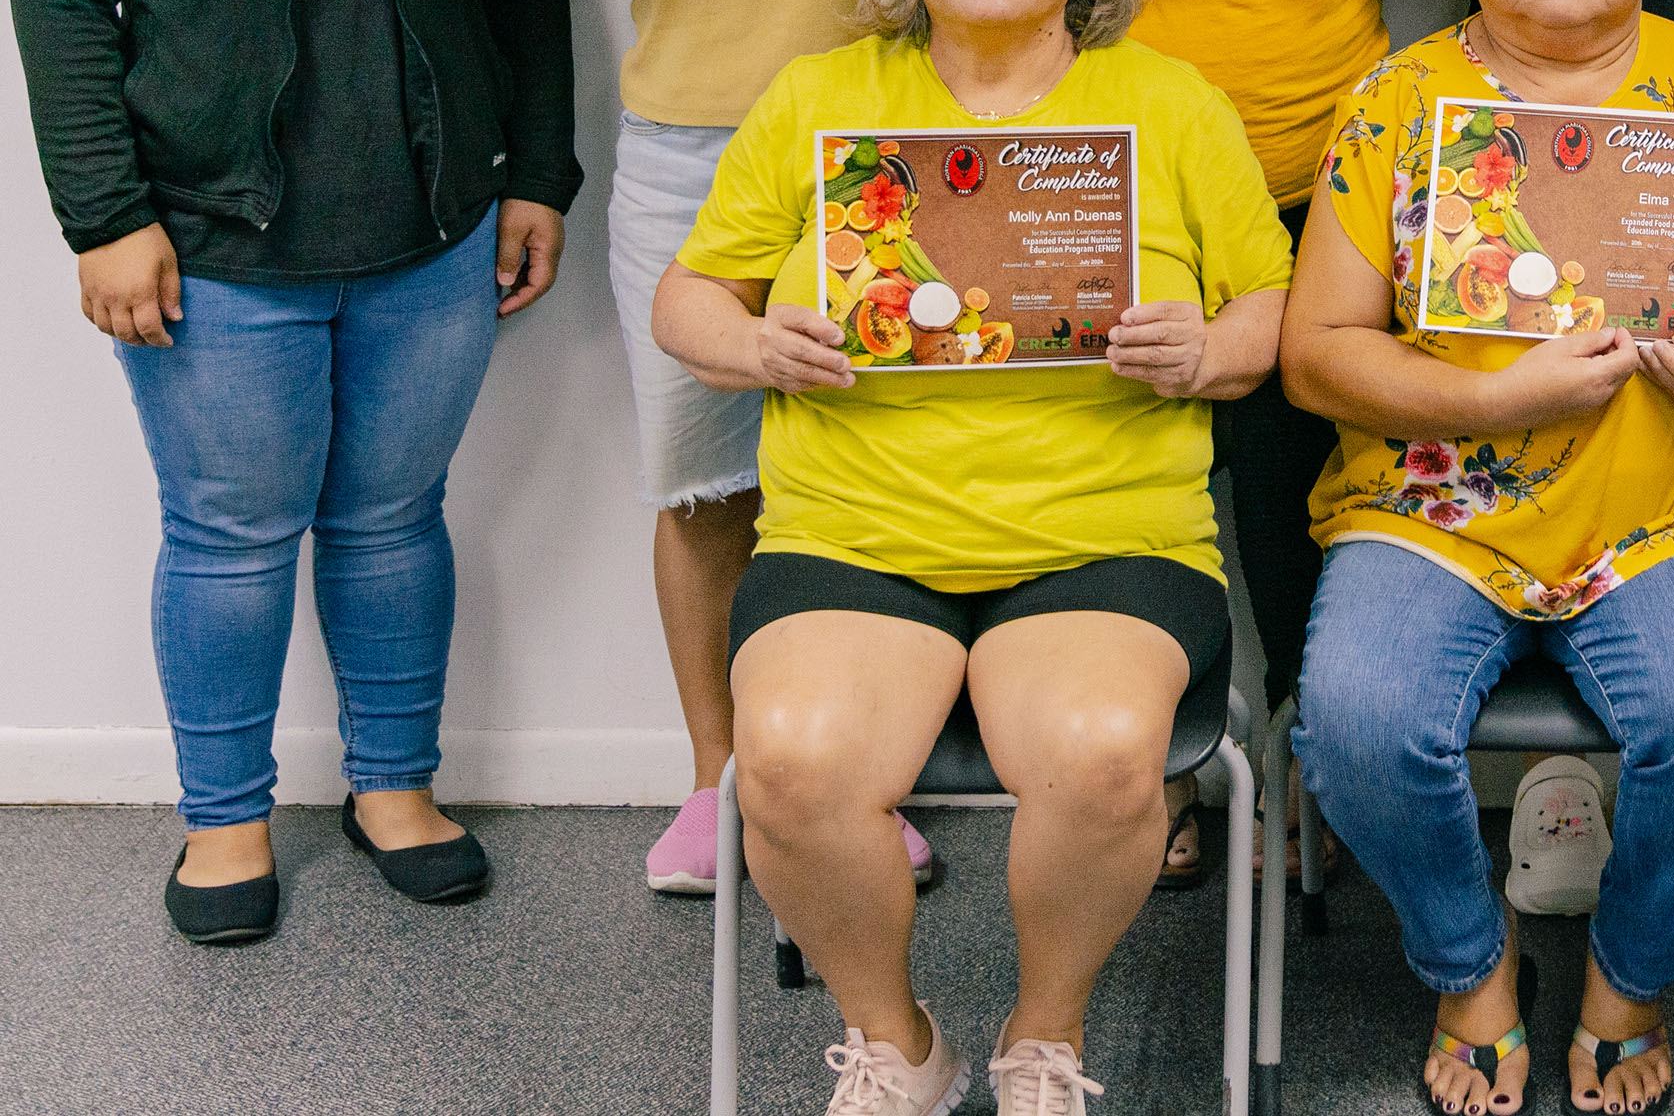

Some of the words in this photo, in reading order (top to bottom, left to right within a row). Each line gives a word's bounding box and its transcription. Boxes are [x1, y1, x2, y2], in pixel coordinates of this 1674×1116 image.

[998, 140, 1096, 170] Certificate
[1099, 142, 1120, 169] of
[1017, 165, 1121, 194] Completion
[1638, 192, 1669, 205] Elma
[1009, 210, 1041, 225] Molly
[1045, 210, 1070, 221] Ann
[1074, 208, 1122, 221] Duenas
[1621, 217, 1653, 227] Expanded
[1654, 219, 1671, 227] Food
[1626, 226, 1659, 235] Education
[1022, 237, 1056, 245] Expanded
[1057, 236, 1074, 244] Food
[1090, 235, 1121, 243] Nutrition
[1029, 245, 1063, 254] Education
[1064, 244, 1094, 254] Program
[1094, 243, 1122, 253] (EFNEP)
[1080, 334, 1109, 349] EFN
